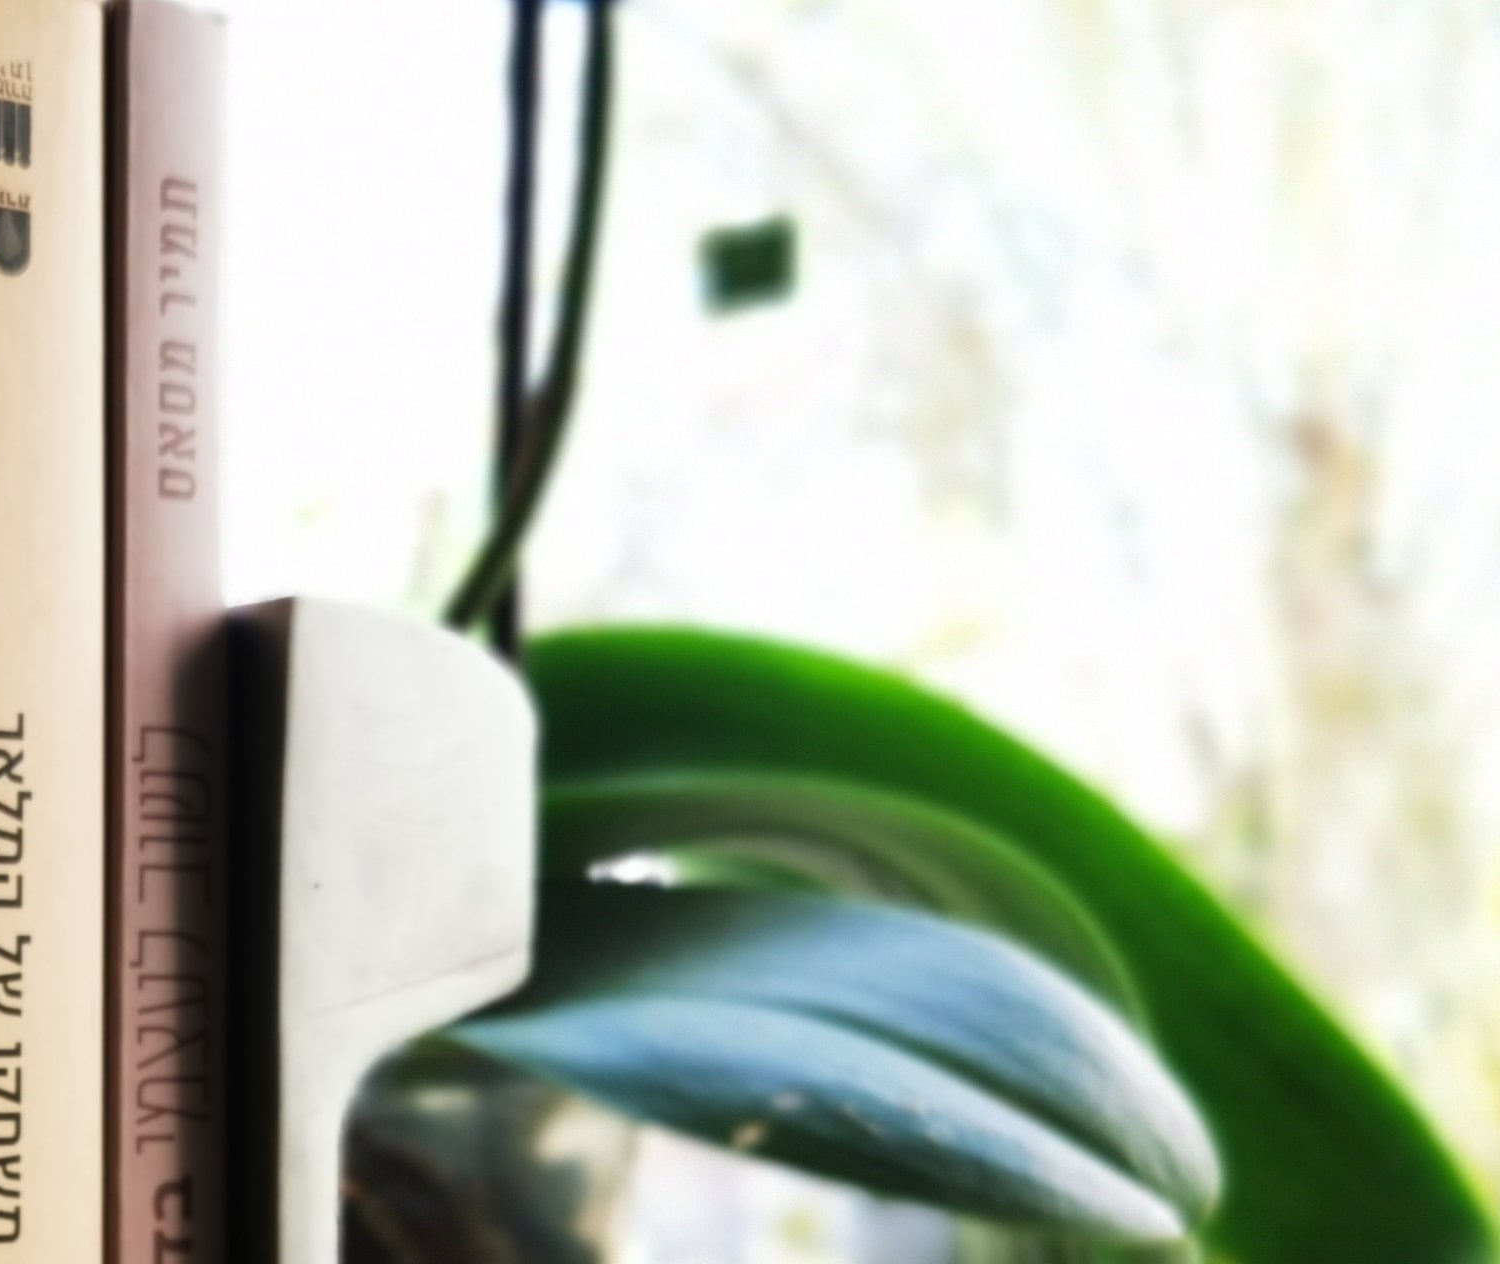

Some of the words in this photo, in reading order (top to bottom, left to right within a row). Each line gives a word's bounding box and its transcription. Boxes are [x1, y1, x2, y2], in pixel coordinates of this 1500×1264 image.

[157, 176, 199, 318] תמיר
[156, 339, 198, 501] מסאס
[131, 725, 213, 904] לשוב
[129, 929, 211, 1155] לעצמי
